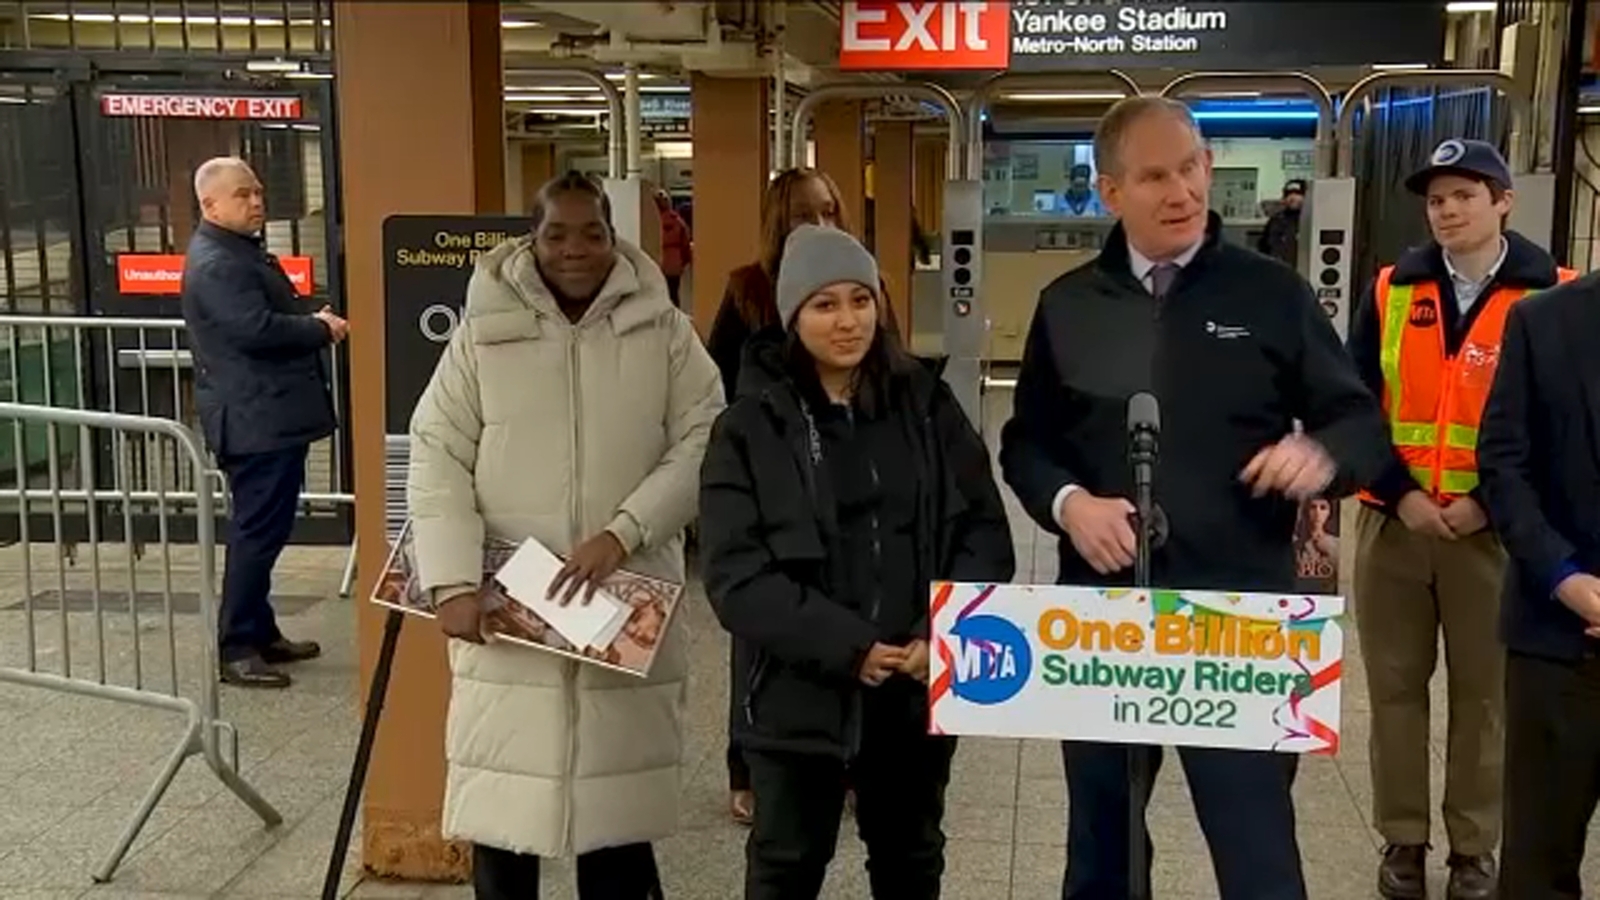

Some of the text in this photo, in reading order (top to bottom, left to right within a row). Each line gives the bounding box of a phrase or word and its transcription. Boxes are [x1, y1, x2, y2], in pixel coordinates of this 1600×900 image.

[843, 2, 988, 51] Exit
[1012, 7, 1226, 33] Yankee Stadium
[1013, 34, 1197, 54] Metro-North Station
[108, 96, 295, 117] EMERGENCY EXIT
[435, 231, 513, 248] One Billi
[397, 249, 466, 267] Subway
[1038, 608, 1321, 661] One Billion
[952, 634, 1017, 683] MTA
[1042, 653, 1313, 698] Subway Riders
[1113, 693, 1237, 728] in 2022
